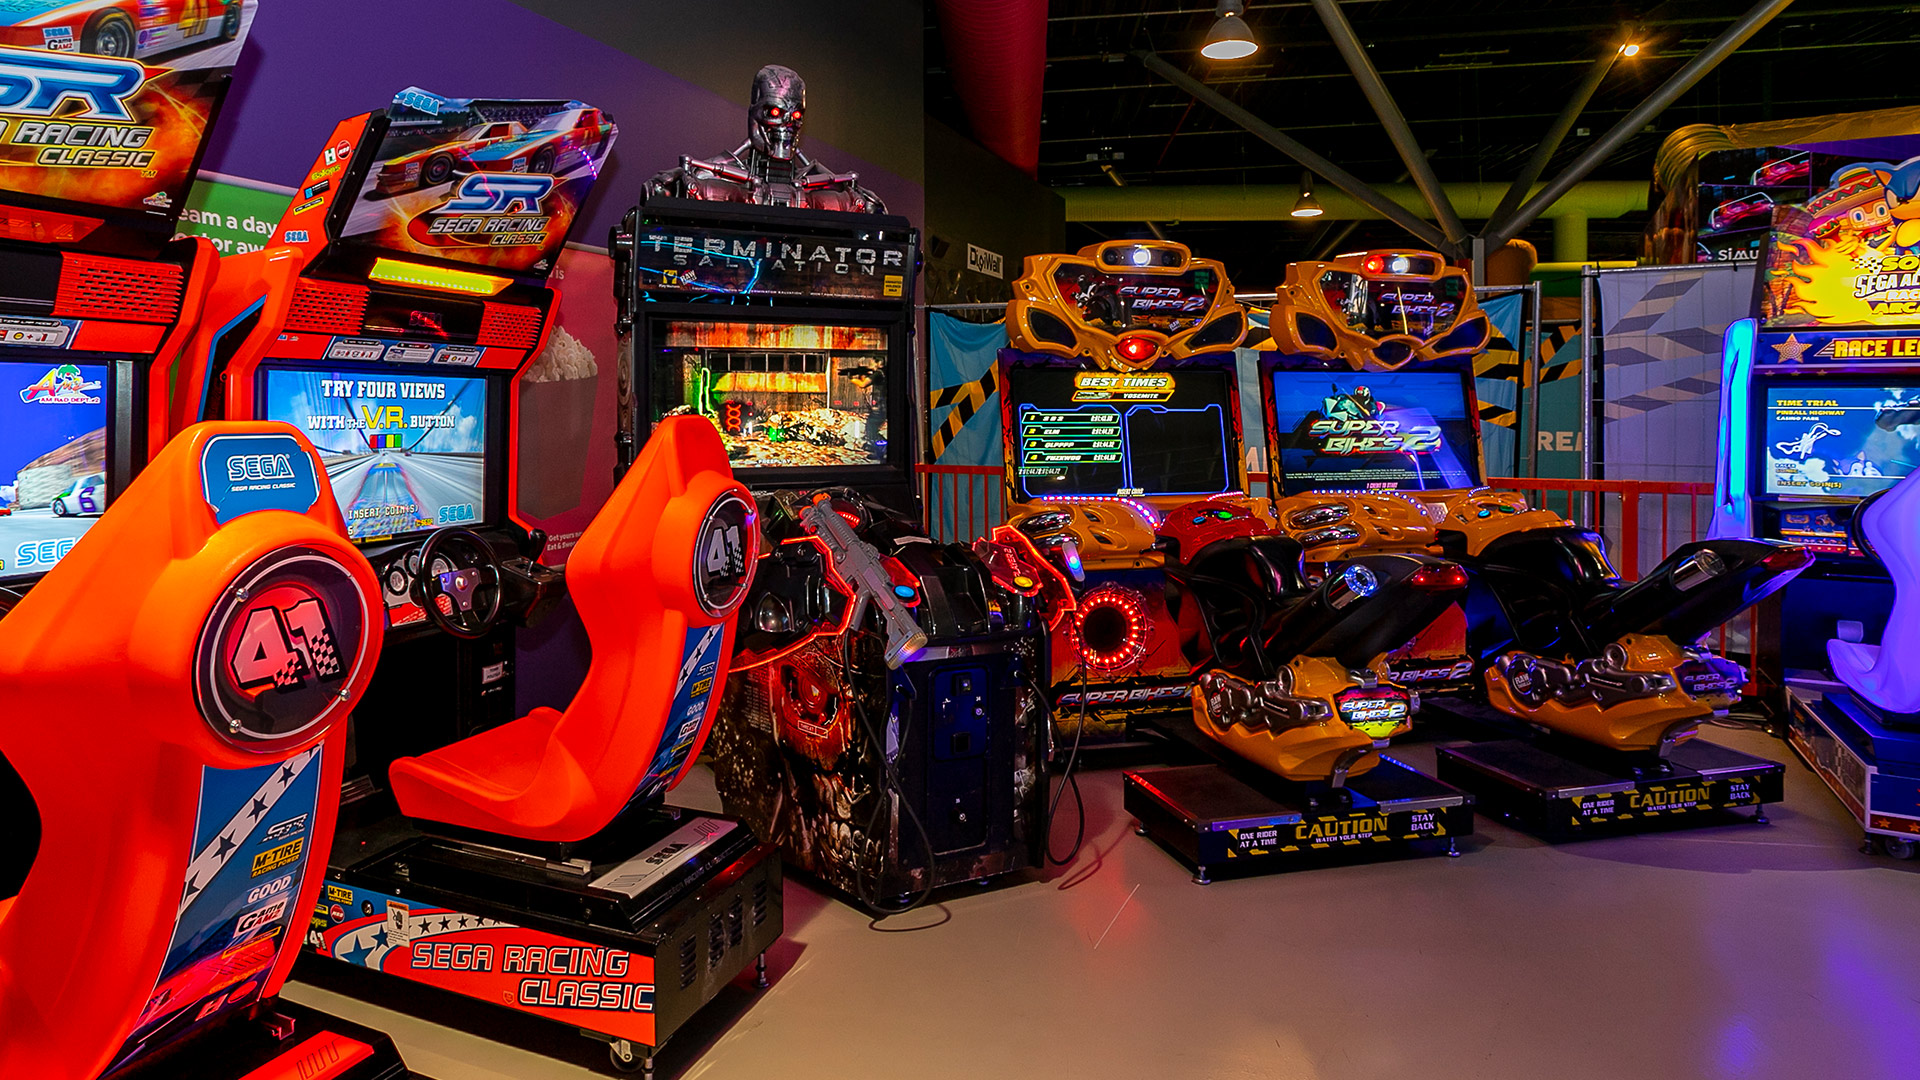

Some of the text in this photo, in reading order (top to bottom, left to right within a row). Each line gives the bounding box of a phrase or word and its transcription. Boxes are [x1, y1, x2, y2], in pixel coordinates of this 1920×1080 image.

[404, 91, 441, 116] SEGA
[12, 122, 153, 147] RACING
[39, 149, 154, 167] CLASSIC
[226, 216, 238, 230] a
[429, 217, 548, 233] SEGA RACING
[285, 230, 309, 242] SEGA
[491, 233, 546, 245] CLASSIC
[649, 233, 904, 268] TERMINATOR
[673, 254, 876, 277] SALVATION
[1881, 255, 1920, 272] SO
[555, 265, 565, 280] is
[1119, 286, 1181, 297] SUPER
[1853, 273, 1898, 298] SEGA
[1381, 292, 1435, 303] SUPER
[1886, 289, 1920, 301] RAC
[1131, 296, 1205, 312] BIKES 2
[1391, 302, 1455, 317] BIKES 2
[1872, 302, 1920, 315] ARC
[1834, 339, 1920, 357] RACE LE
[321, 379, 446, 399] TRY FOUR VIEWS
[1080, 377, 1168, 388] BEST TIMES
[307, 405, 455, 430] WITH THE V.R. BUTTON
[1309, 419, 1400, 436] SUPER
[1324, 425, 1443, 455] BIKES 2
[227, 454, 296, 482] SEGA
[272, 482, 296, 490] CLASSIC
[348, 507, 380, 520] INSERT
[438, 503, 475, 524] SEGA
[548, 534, 559, 542] Get
[706, 525, 747, 577] 41
[231, 597, 348, 692] 41
[1400, 667, 1452, 682] BIKES
[1449, 661, 1473, 680] 2
[1061, 689, 1128, 704] SUPER
[1128, 685, 1187, 701] BIKES
[1341, 699, 1386, 711] SUPER
[1351, 703, 1407, 721] BIKES 2
[1730, 783, 1750, 792] STAY
[1730, 791, 1750, 800] BACK
[1630, 787, 1710, 808] CAUTION
[1411, 813, 1435, 822] STAY
[1240, 830, 1277, 840] ONE RIDER
[1295, 817, 1388, 840] CAUTION
[1411, 822, 1434, 831] BACK
[1239, 837, 1277, 848] AT A TIME
[1315, 832, 1373, 843] WATCH YOUR STEP
[254, 839, 303, 869] M-TIRE
[645, 842, 690, 866] SEGA
[247, 875, 292, 904] GOOD
[328, 886, 352, 899] M-TIRE
[309, 930, 327, 950] 41
[412, 942, 630, 977] SEGA RACING
[519, 980, 656, 1011] CLASSIC
